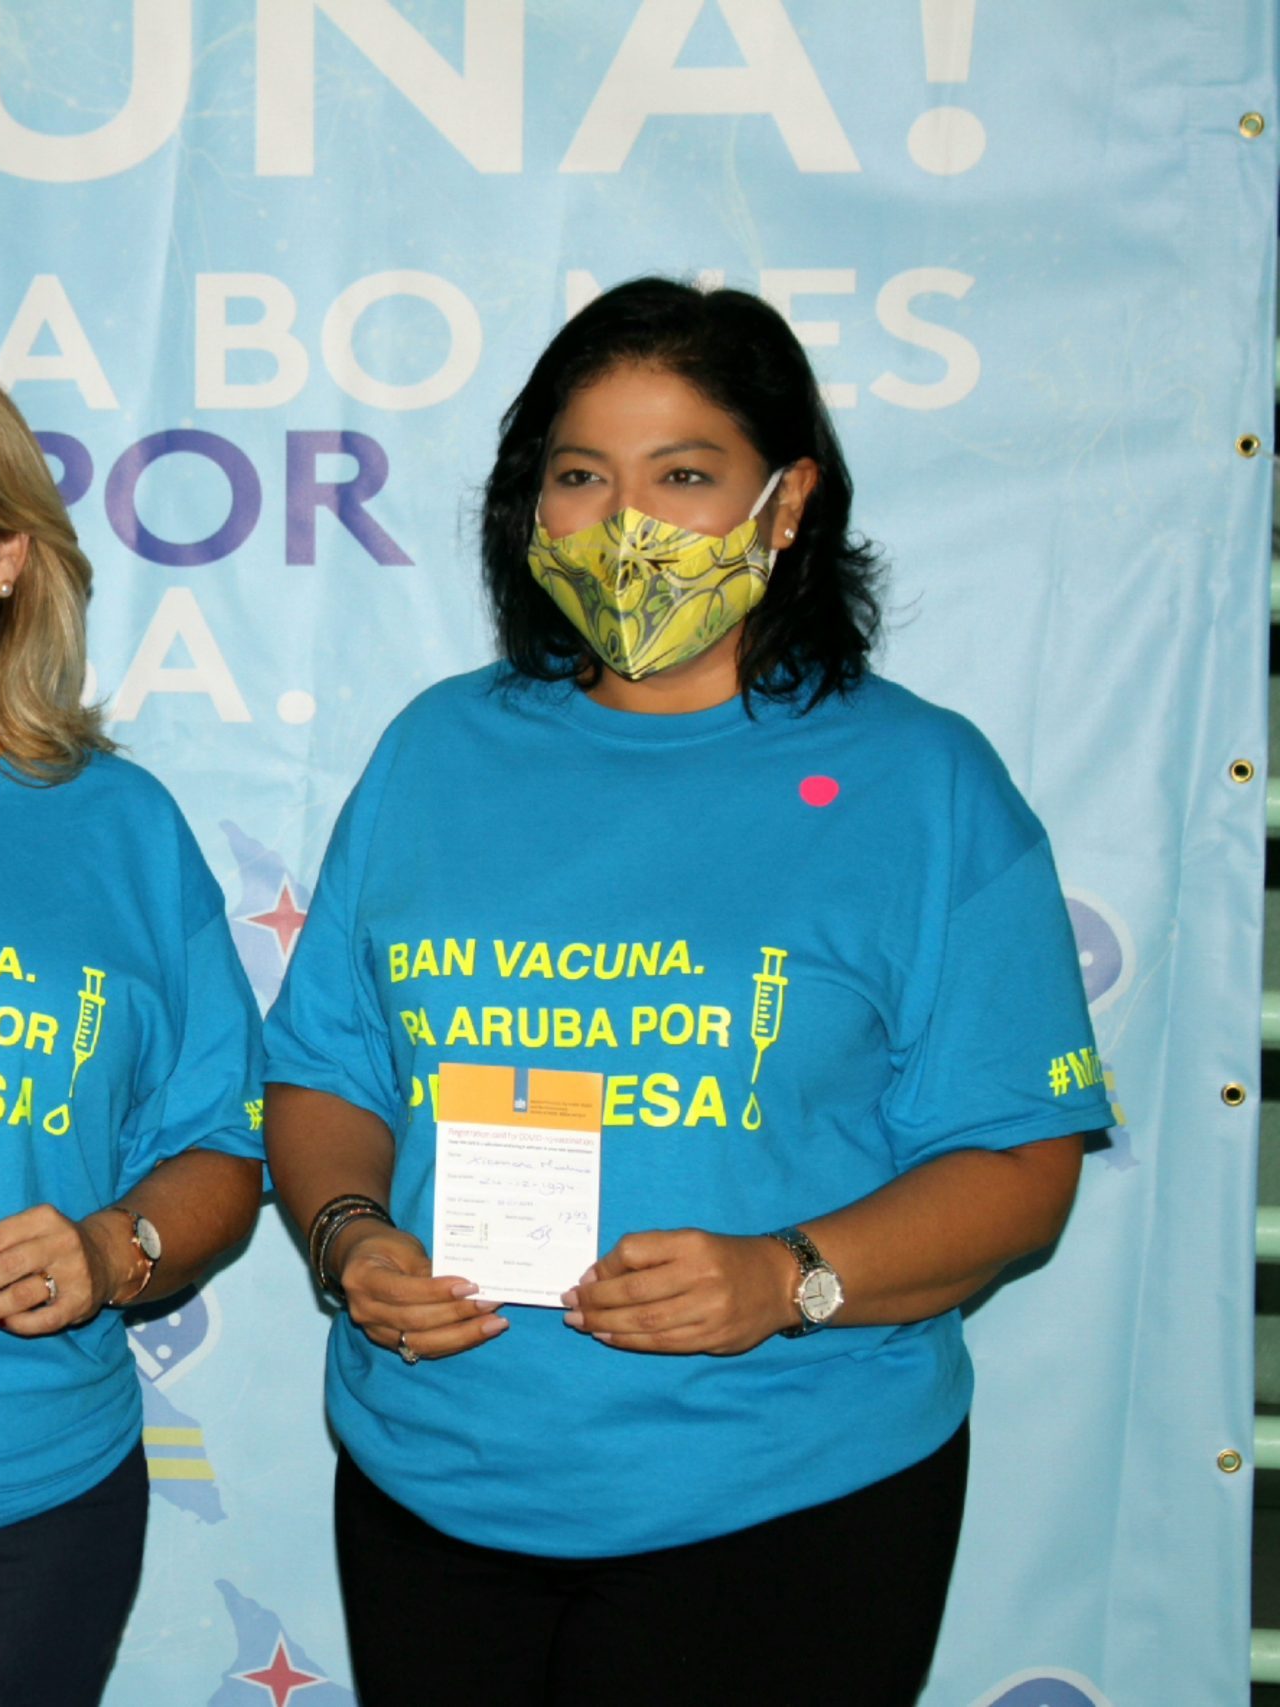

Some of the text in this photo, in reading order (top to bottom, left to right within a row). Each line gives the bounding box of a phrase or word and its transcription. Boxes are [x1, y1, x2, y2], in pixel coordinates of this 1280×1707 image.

[195, 270, 483, 410] BO
[566, 267, 981, 411] ES
[389, 938, 705, 982] BAN VACUNA.
[400, 1003, 732, 1049] PA ARUBA POR
